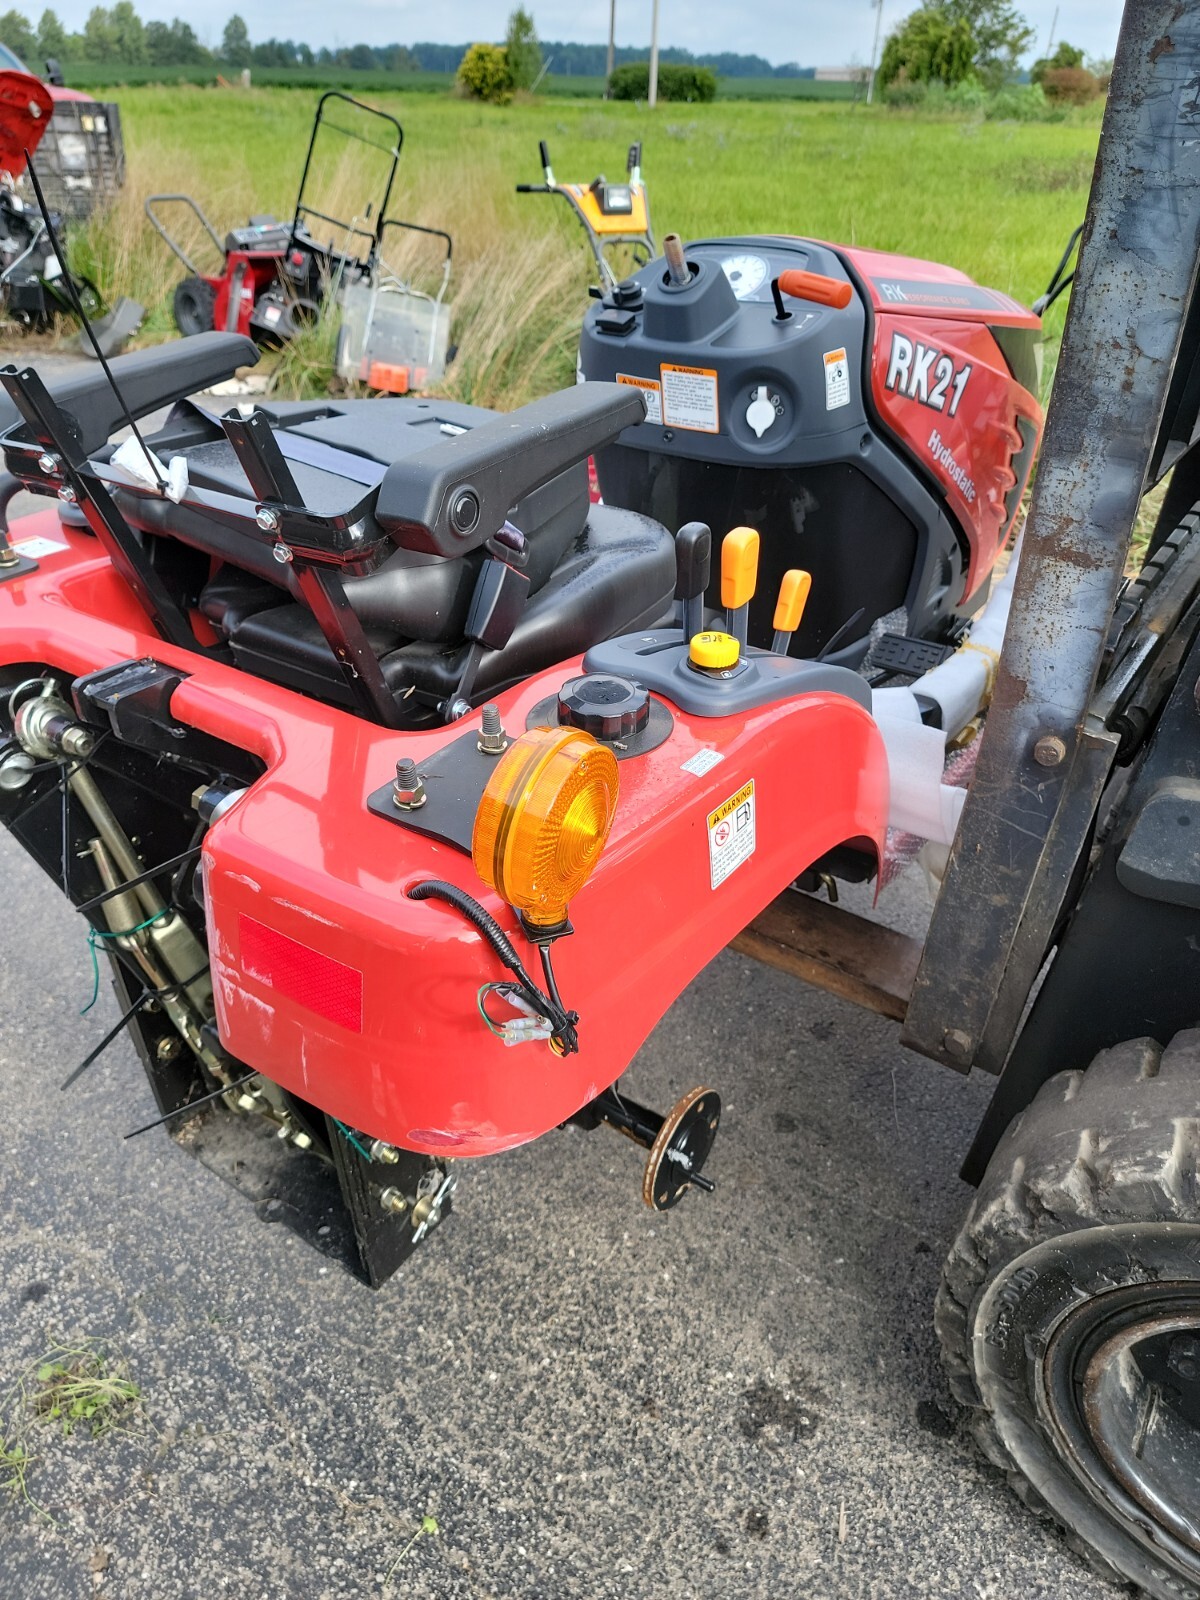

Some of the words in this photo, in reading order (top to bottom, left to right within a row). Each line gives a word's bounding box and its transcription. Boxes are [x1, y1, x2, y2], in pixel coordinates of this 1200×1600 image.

[627, 379, 656, 390] WARNING
[678, 367, 704, 375] WARNING
[885, 330, 973, 418] RK21
[927, 429, 977, 503] Hydrostatic
[721, 786, 751, 816] WARNING
